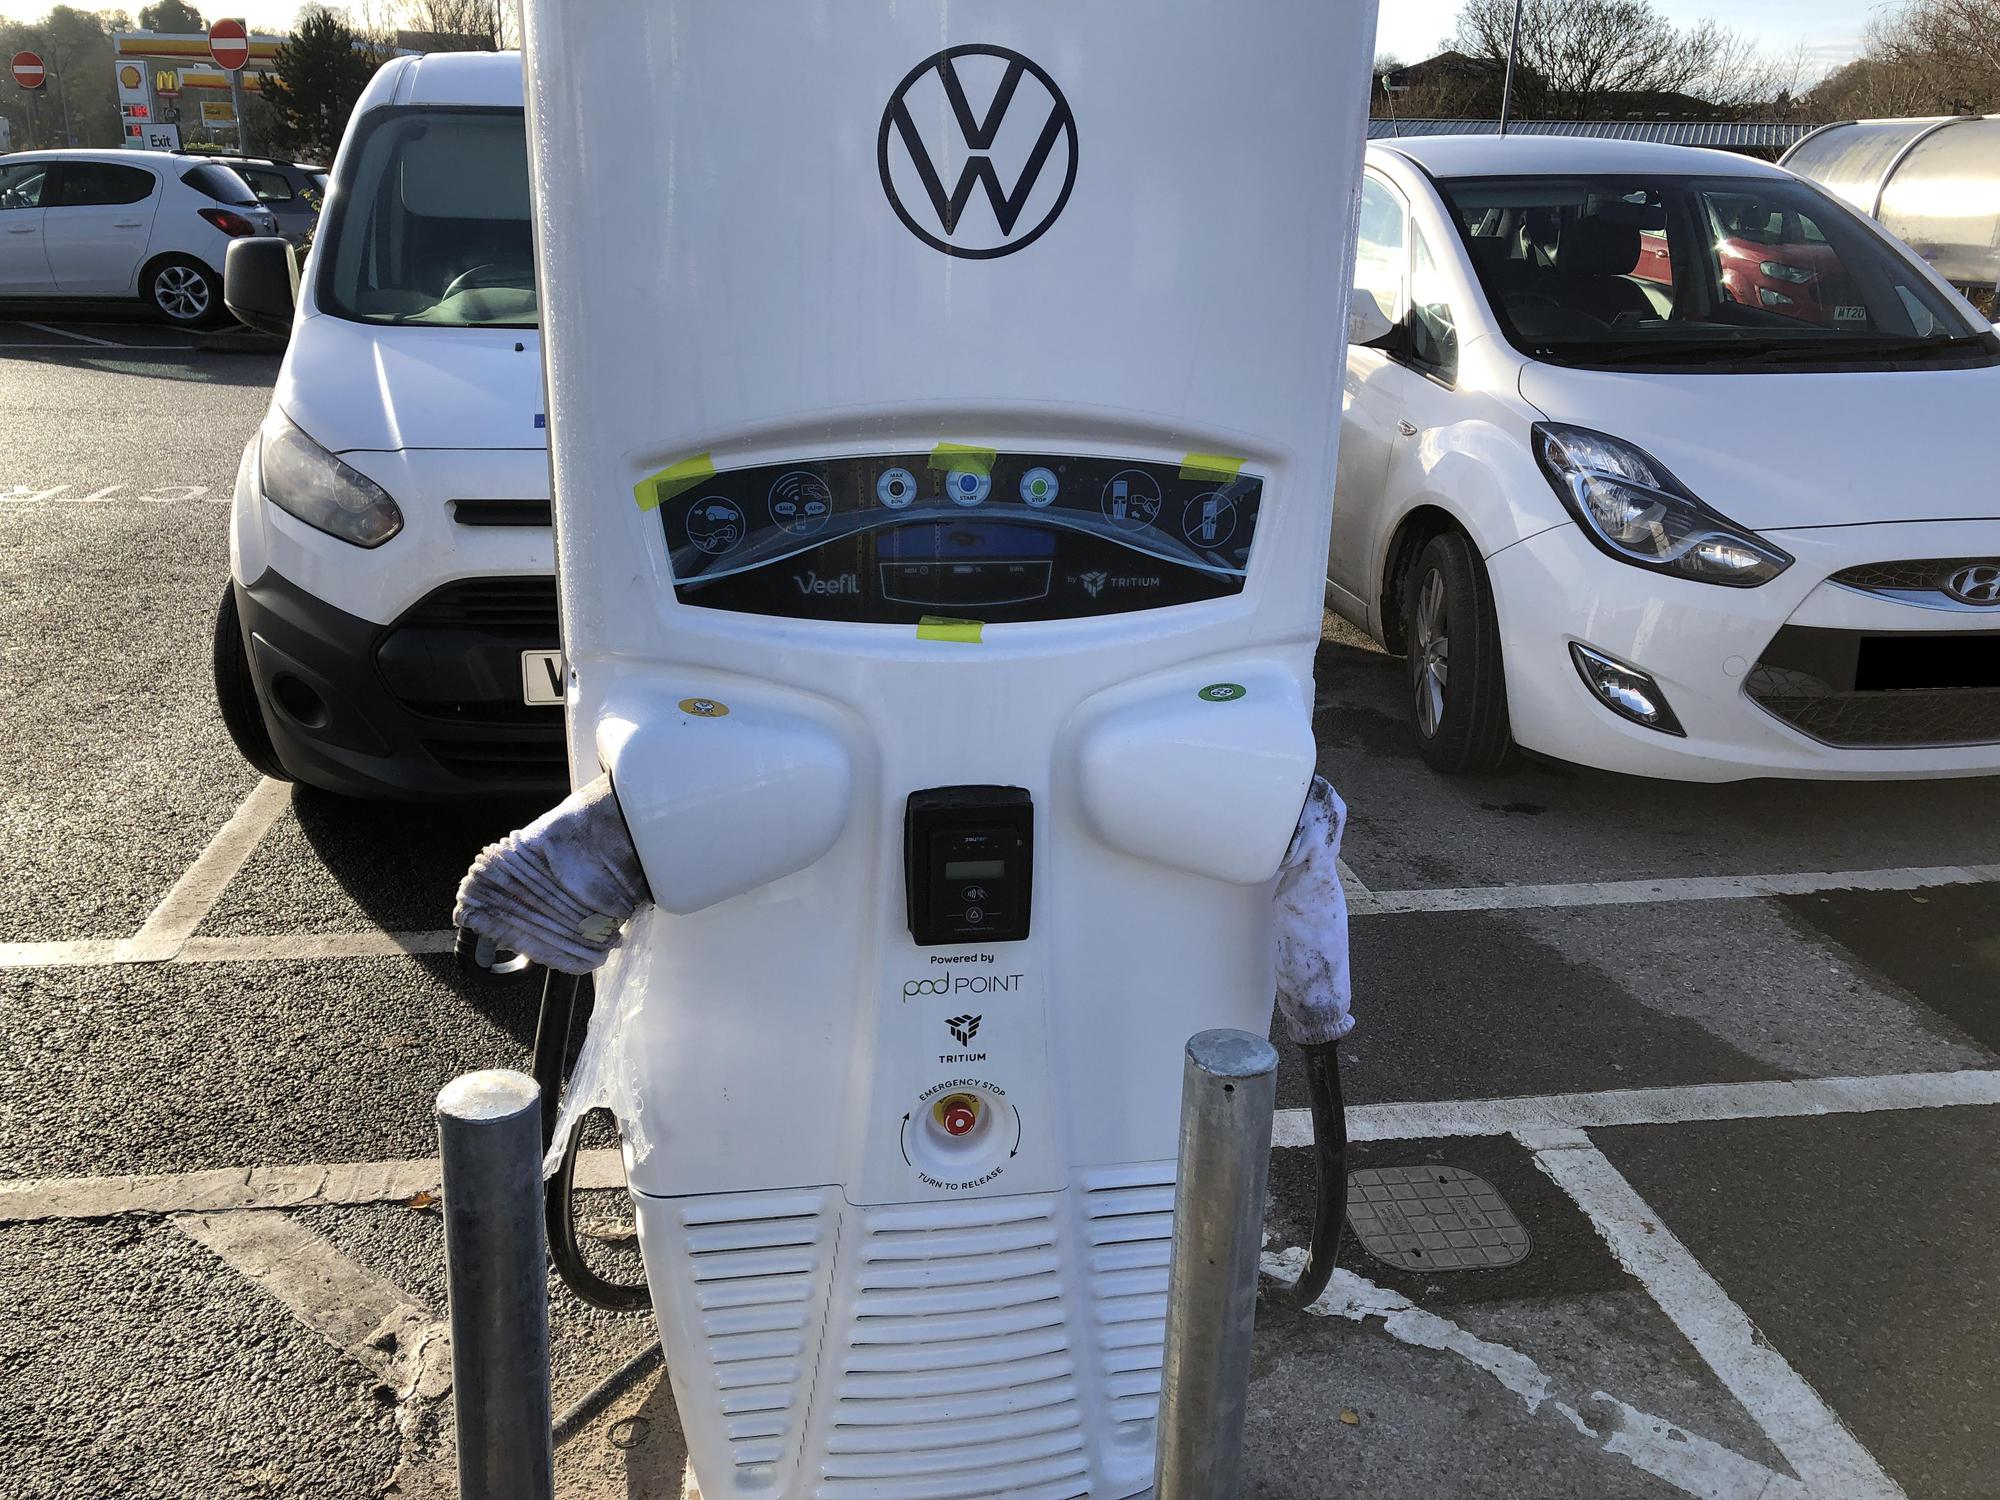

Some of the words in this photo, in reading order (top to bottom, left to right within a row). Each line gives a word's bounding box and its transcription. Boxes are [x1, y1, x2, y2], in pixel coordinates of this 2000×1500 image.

[149, 134, 172, 147] Exit
[1067, 575, 1077, 585] by
[1110, 577, 1160, 588] TRITIUM
[930, 953, 977, 964] Powered
[980, 953, 994, 963] by
[903, 970, 950, 1004] pod
[954, 974, 1025, 994] POINT
[938, 1053, 986, 1063] TRITIUM
[919, 1078, 981, 1102] EMERGENCY
[982, 1081, 1006, 1097] STOP
[917, 1171, 943, 1189] TURN
[944, 1182, 958, 1190] TO
[961, 1166, 1004, 1190] RELEASE
